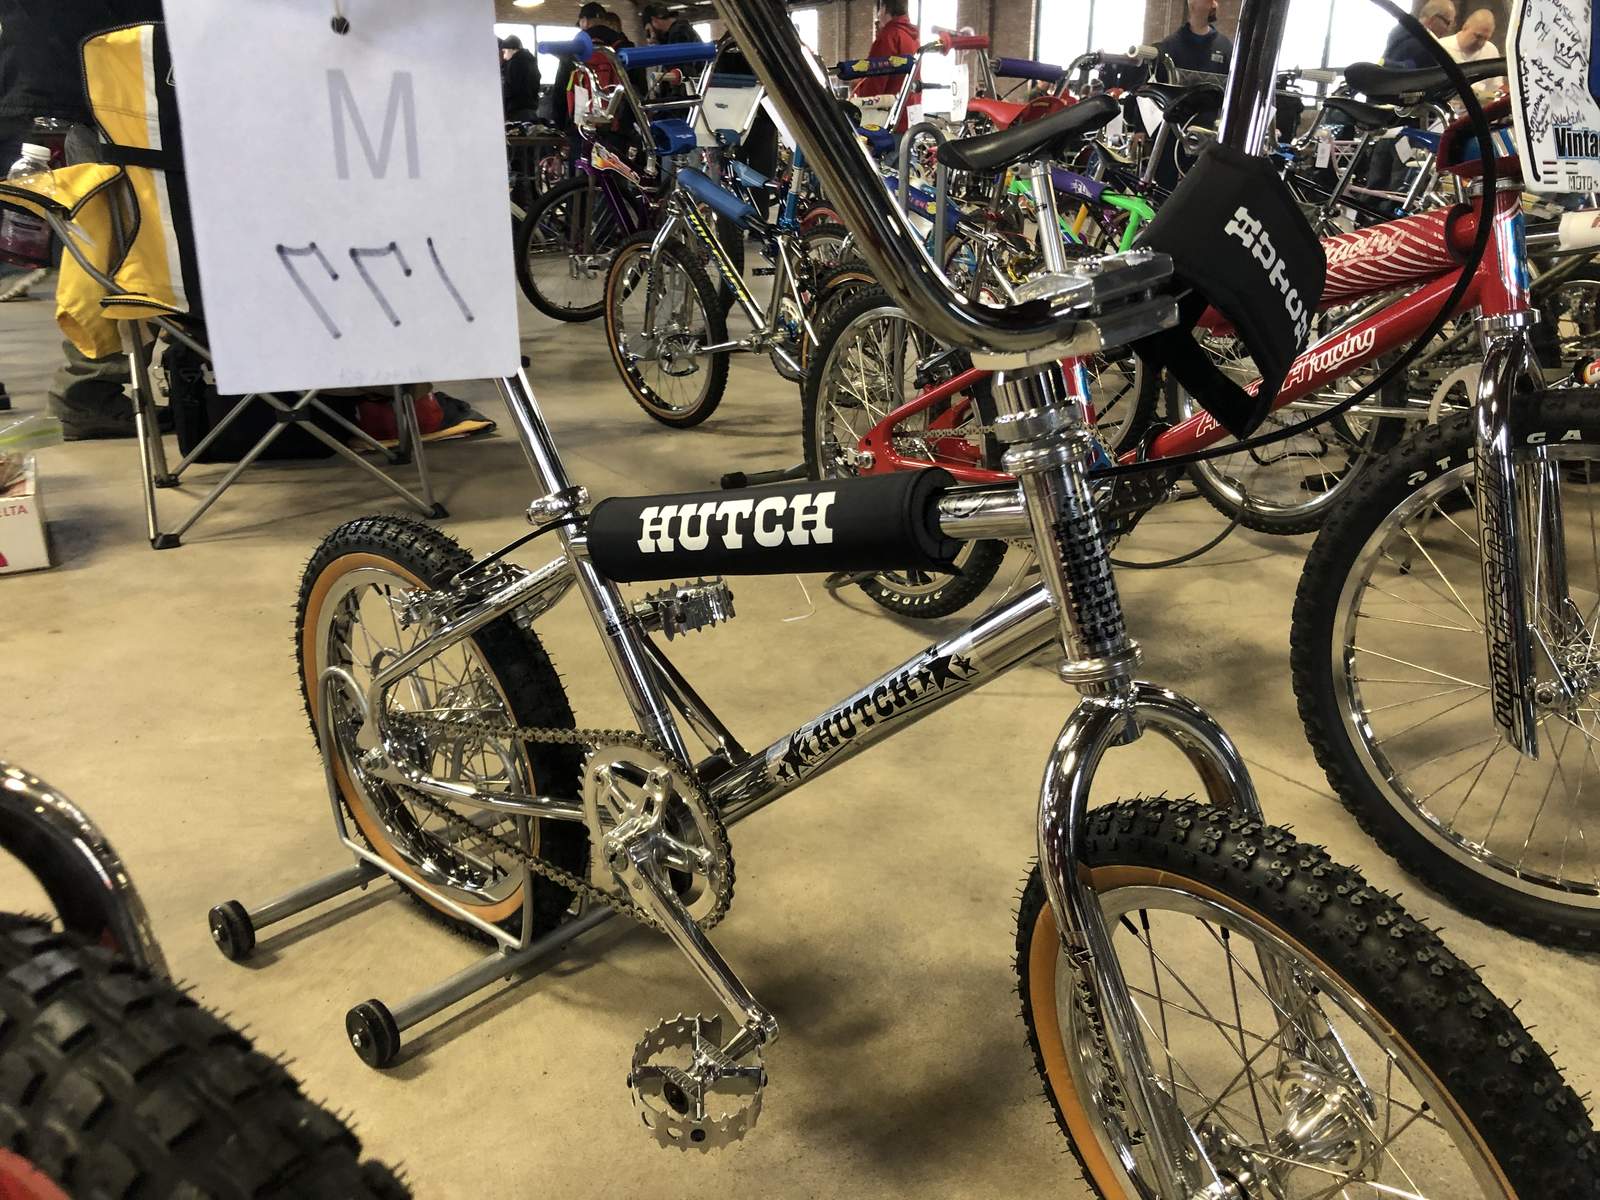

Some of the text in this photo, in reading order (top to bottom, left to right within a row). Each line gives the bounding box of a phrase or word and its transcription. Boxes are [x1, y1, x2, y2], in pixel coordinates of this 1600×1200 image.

[1553, 127, 1600, 158] Vinta
[1224, 206, 1308, 350] HUTCH
[1307, 326, 1377, 383] racing
[1436, 429, 1582, 472] TIGA
[0, 504, 28, 518] LTA
[637, 491, 836, 553] HUTCH
[813, 670, 918, 753] HUTCH
